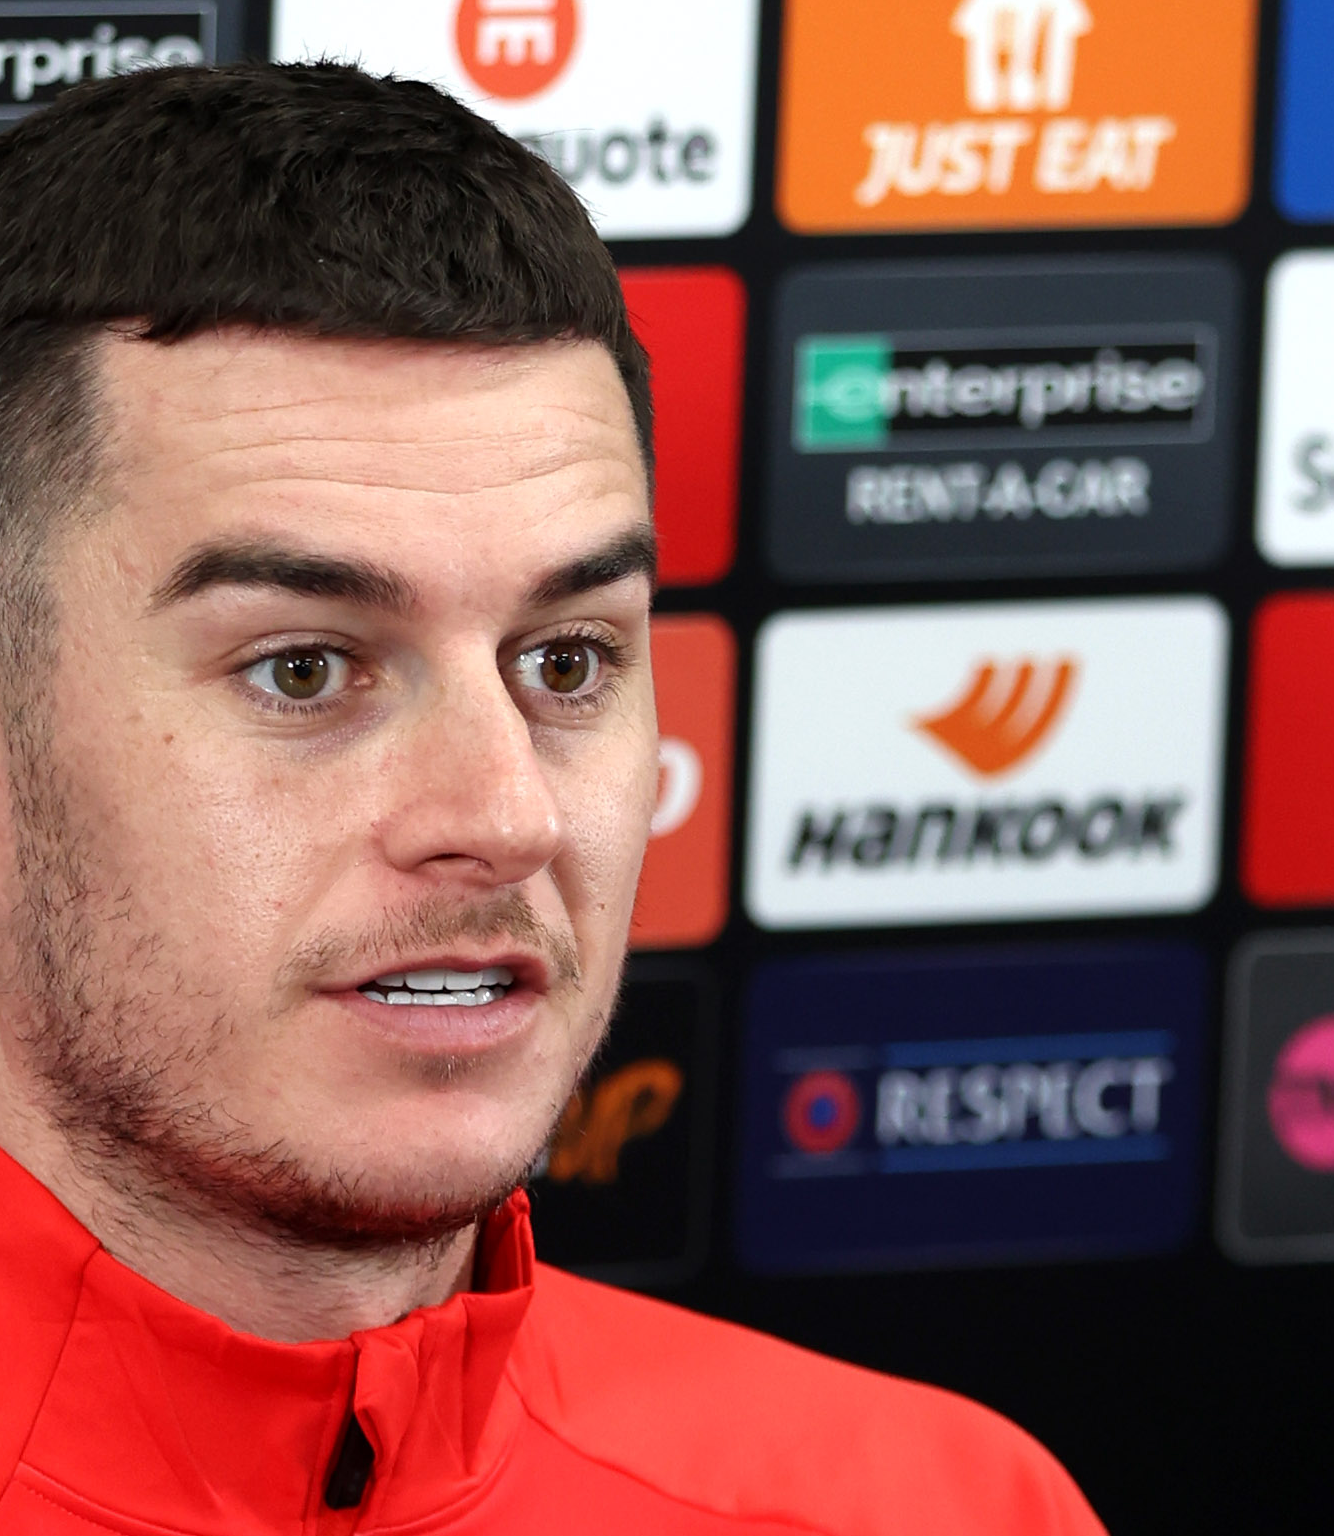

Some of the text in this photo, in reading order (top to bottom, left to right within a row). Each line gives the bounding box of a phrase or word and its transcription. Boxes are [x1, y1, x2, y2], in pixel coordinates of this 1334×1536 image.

[855, 116, 1175, 207] JUST EAT
[824, 348, 1204, 429] enterprise
[874, 1058, 1174, 1145] RESPECT
